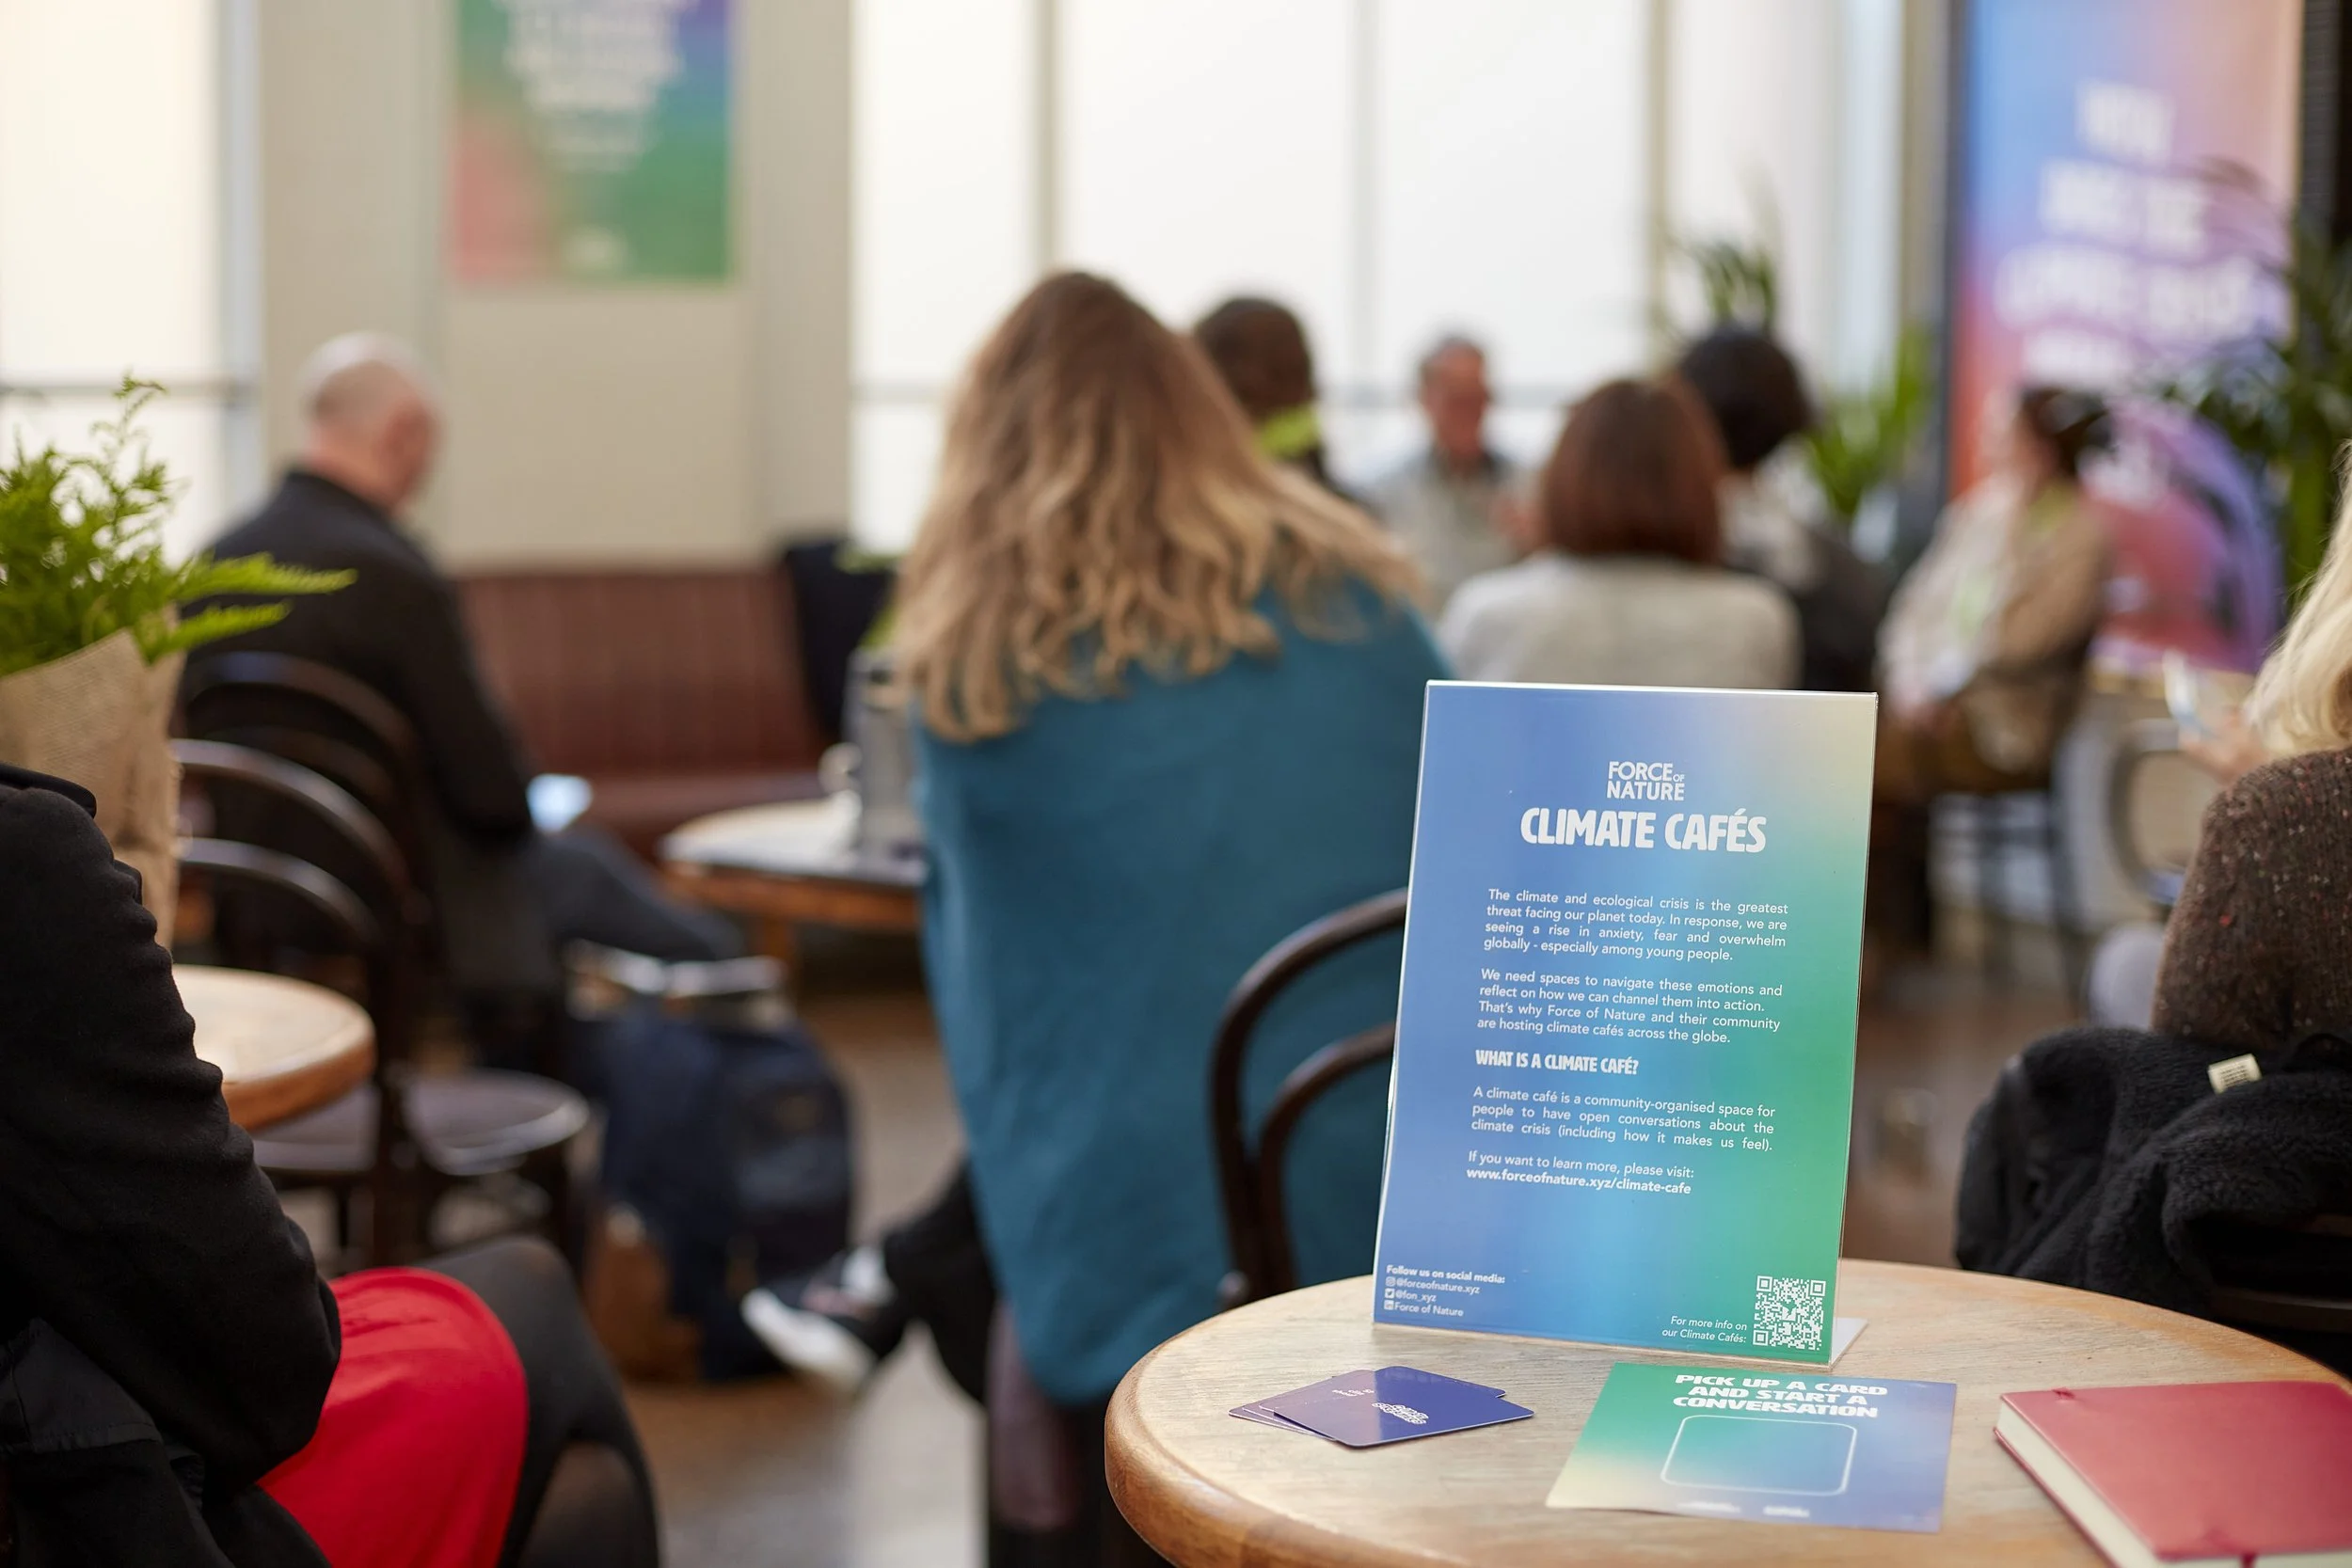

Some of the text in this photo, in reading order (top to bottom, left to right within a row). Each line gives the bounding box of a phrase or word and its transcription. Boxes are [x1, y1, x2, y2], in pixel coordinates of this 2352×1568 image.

[1608, 761, 1685, 782] FORCE OF
[1607, 781, 1685, 800] NATURE
[1520, 807, 1767, 853] CLIMATE CAFÉS
[1488, 888, 1788, 915] The climate and ecological crisis is the greatest
[1486, 904, 1788, 930] threat facing our planet today. In response, we are
[1485, 921, 1786, 946] seeing a rise in anxiety, fear and overwhelm
[1484, 936, 1531, 953] globally
[1540, 941, 1598, 956] especially
[1601, 945, 1644, 958] among
[1645, 947, 1684, 961] young
[1687, 947, 1733, 963] people.
[1481, 968, 1783, 996] We need spaces to navigate these emotions and
[1480, 984, 1765, 1011] reflect on how we can channel them into action.
[1477, 1017, 1730, 1044] are hosting climate cafés across the globe.
[1518, 1003, 1543, 1019] why
[1548, 1004, 1581, 1018] Force
[1585, 1006, 1599, 1019] of
[1604, 1007, 1645, 1022] Nature
[1651, 1011, 1674, 1023] and
[1678, 1011, 1708, 1025] their
[1712, 1017, 1781, 1033] community
[1475, 1050, 1639, 1075] WHAT IS A CLIMATE CAFÉ?
[1473, 1085, 1775, 1118] A climate café is a community-organised space for
[1472, 1103, 1774, 1134] people to have open conversations about the
[1471, 1118, 1772, 1152] climate crisis (including how it makes us feel).
[1469, 1149, 1694, 1179] If you want to learn more, please visit:
[1467, 1168, 1692, 1194] www.forceofnature.xyz/climate-cafe
[1386, 1264, 1418, 1275] Follow
[1445, 1271, 1472, 1280] social
[1473, 1274, 1505, 1283] media:
[1394, 1302, 1464, 1317] Force of Nature
[1671, 1315, 1687, 1325] For
[1688, 1320, 1713, 1328] more
[1715, 1319, 1733, 1330] info
[1679, 1328, 1716, 1340] Climate
[1717, 1332, 1747, 1343] Cafés:
[1675, 1374, 1887, 1395] PICK UP A CARD
[1688, 1386, 1867, 1404] AND START A
[1673, 1397, 1878, 1417] CONVERSATION
